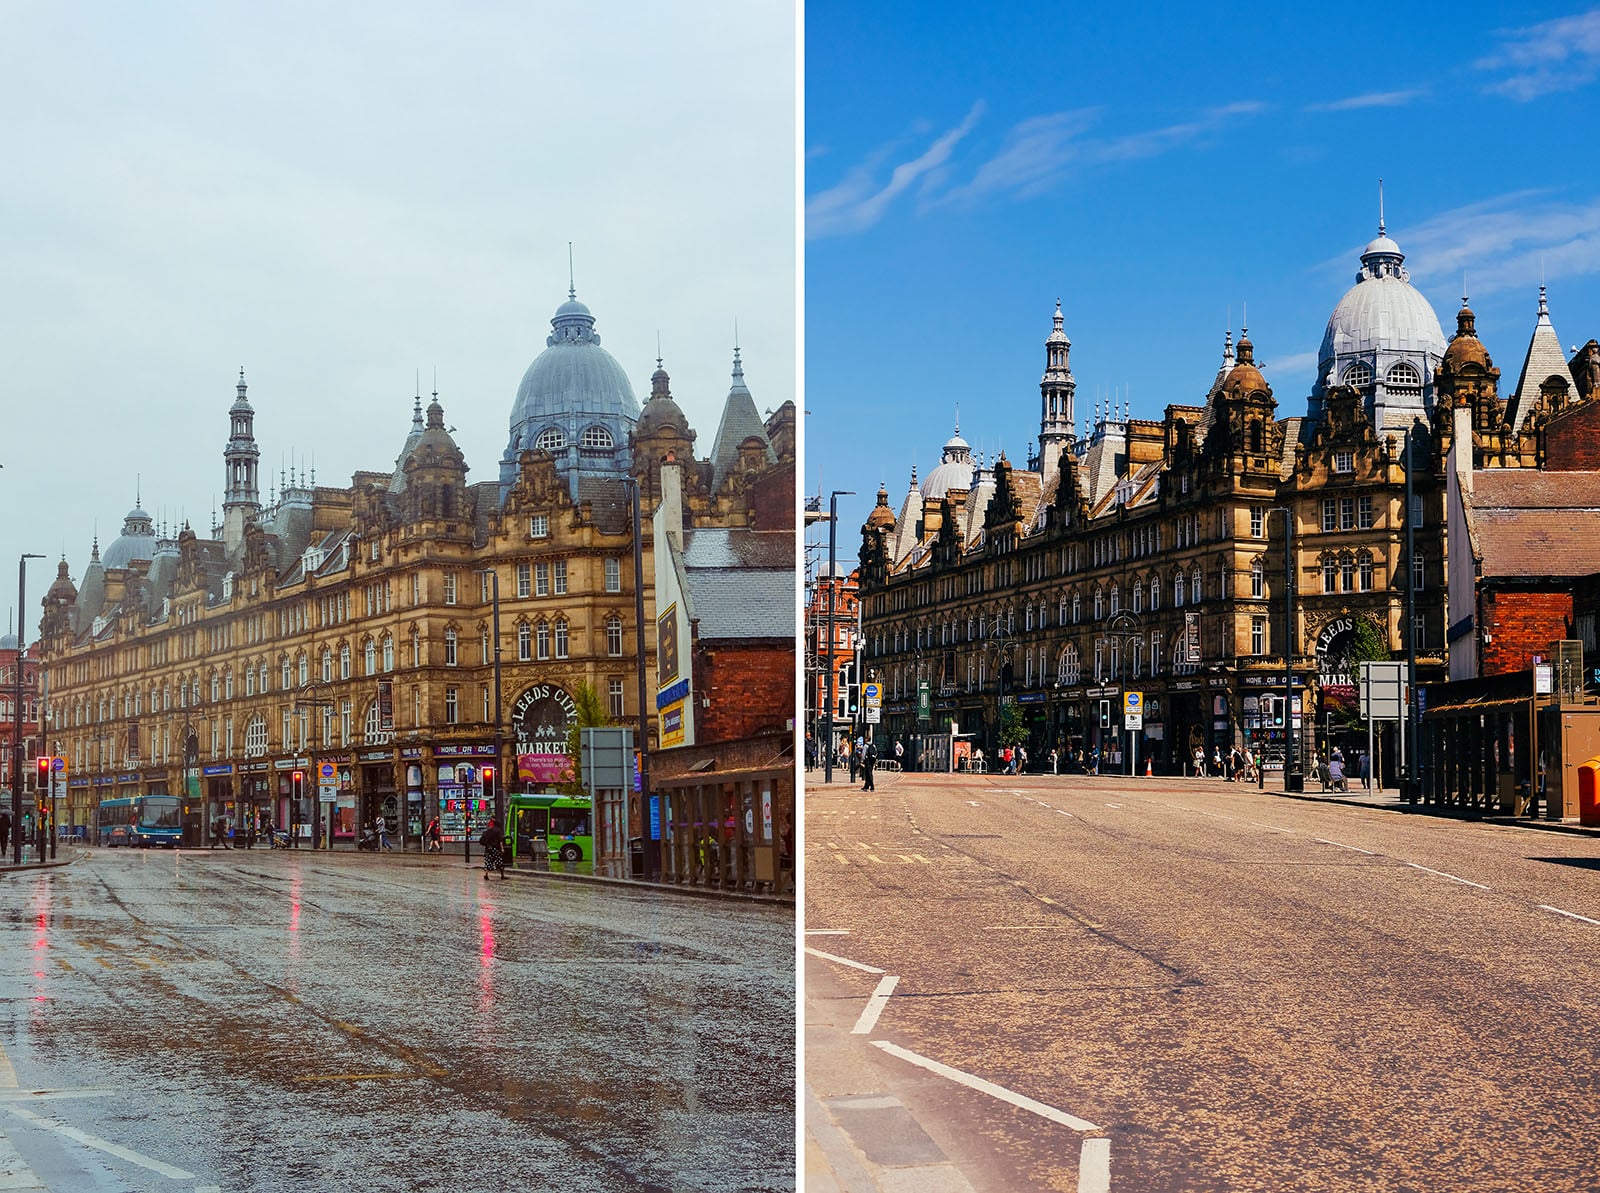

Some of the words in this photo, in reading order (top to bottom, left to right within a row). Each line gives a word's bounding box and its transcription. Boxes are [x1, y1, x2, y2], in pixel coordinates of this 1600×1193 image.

[1316, 618, 1353, 652] LEEDS
[1319, 673, 1355, 687] MARK
[512, 685, 550, 720] LEEDS
[553, 689, 578, 718] CITY
[474, 745, 488, 753] YOU
[515, 741, 568, 755] MARKET
